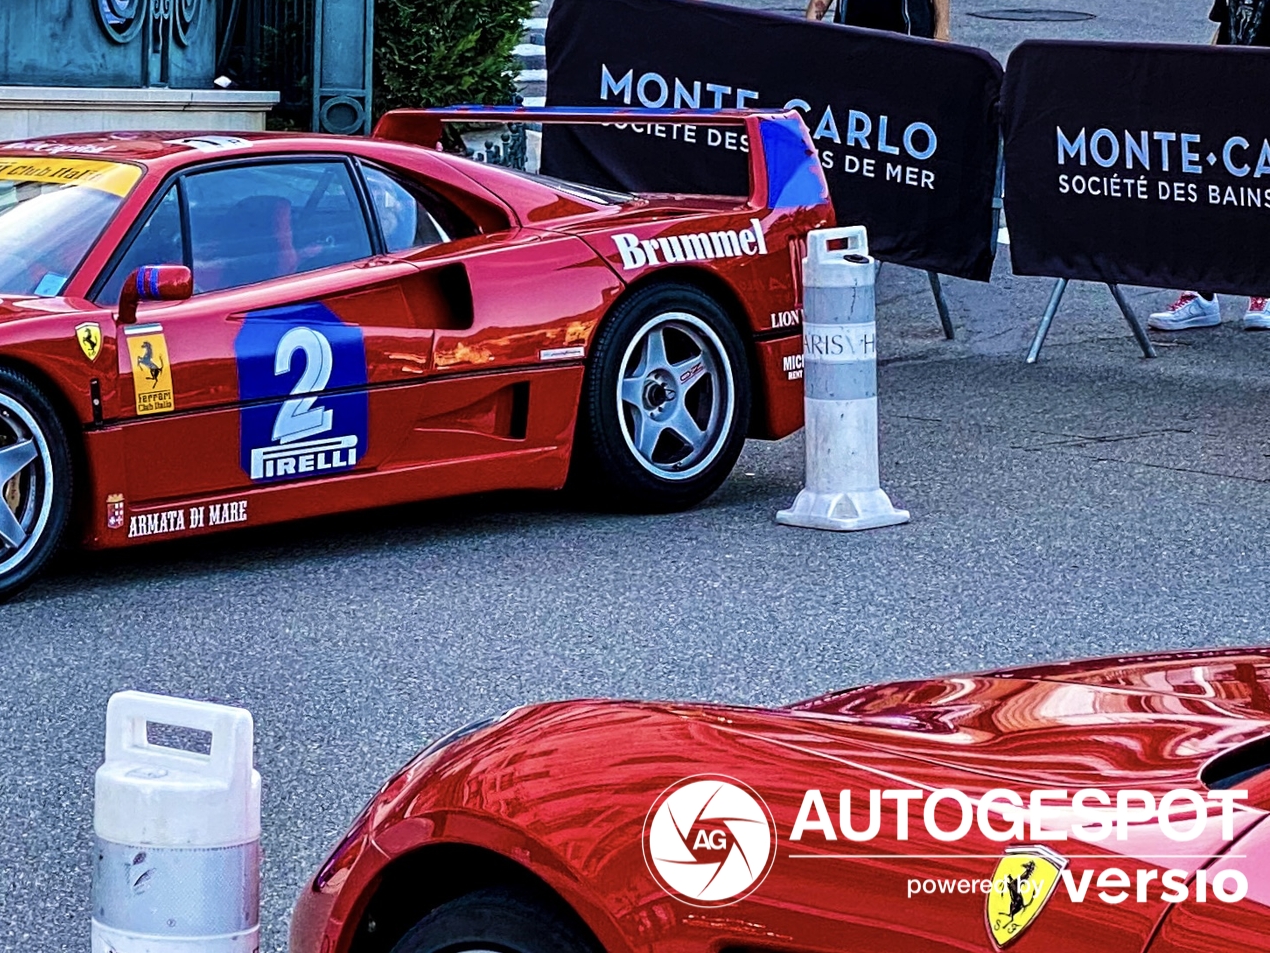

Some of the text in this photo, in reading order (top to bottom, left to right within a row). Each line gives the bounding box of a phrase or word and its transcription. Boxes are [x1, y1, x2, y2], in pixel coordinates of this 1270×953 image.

[8, 165, 51, 177] Club
[845, 155, 875, 178] DE
[886, 162, 936, 190] MER
[1058, 173, 1148, 200] SOCIÉTÉ
[1158, 181, 1198, 203] DES
[611, 218, 769, 270] Brummel
[771, 309, 803, 328] LION
[271, 326, 333, 445] 2
[250, 435, 358, 479] PIRELLI
[128, 500, 248, 538] ARMATA DI MARE
